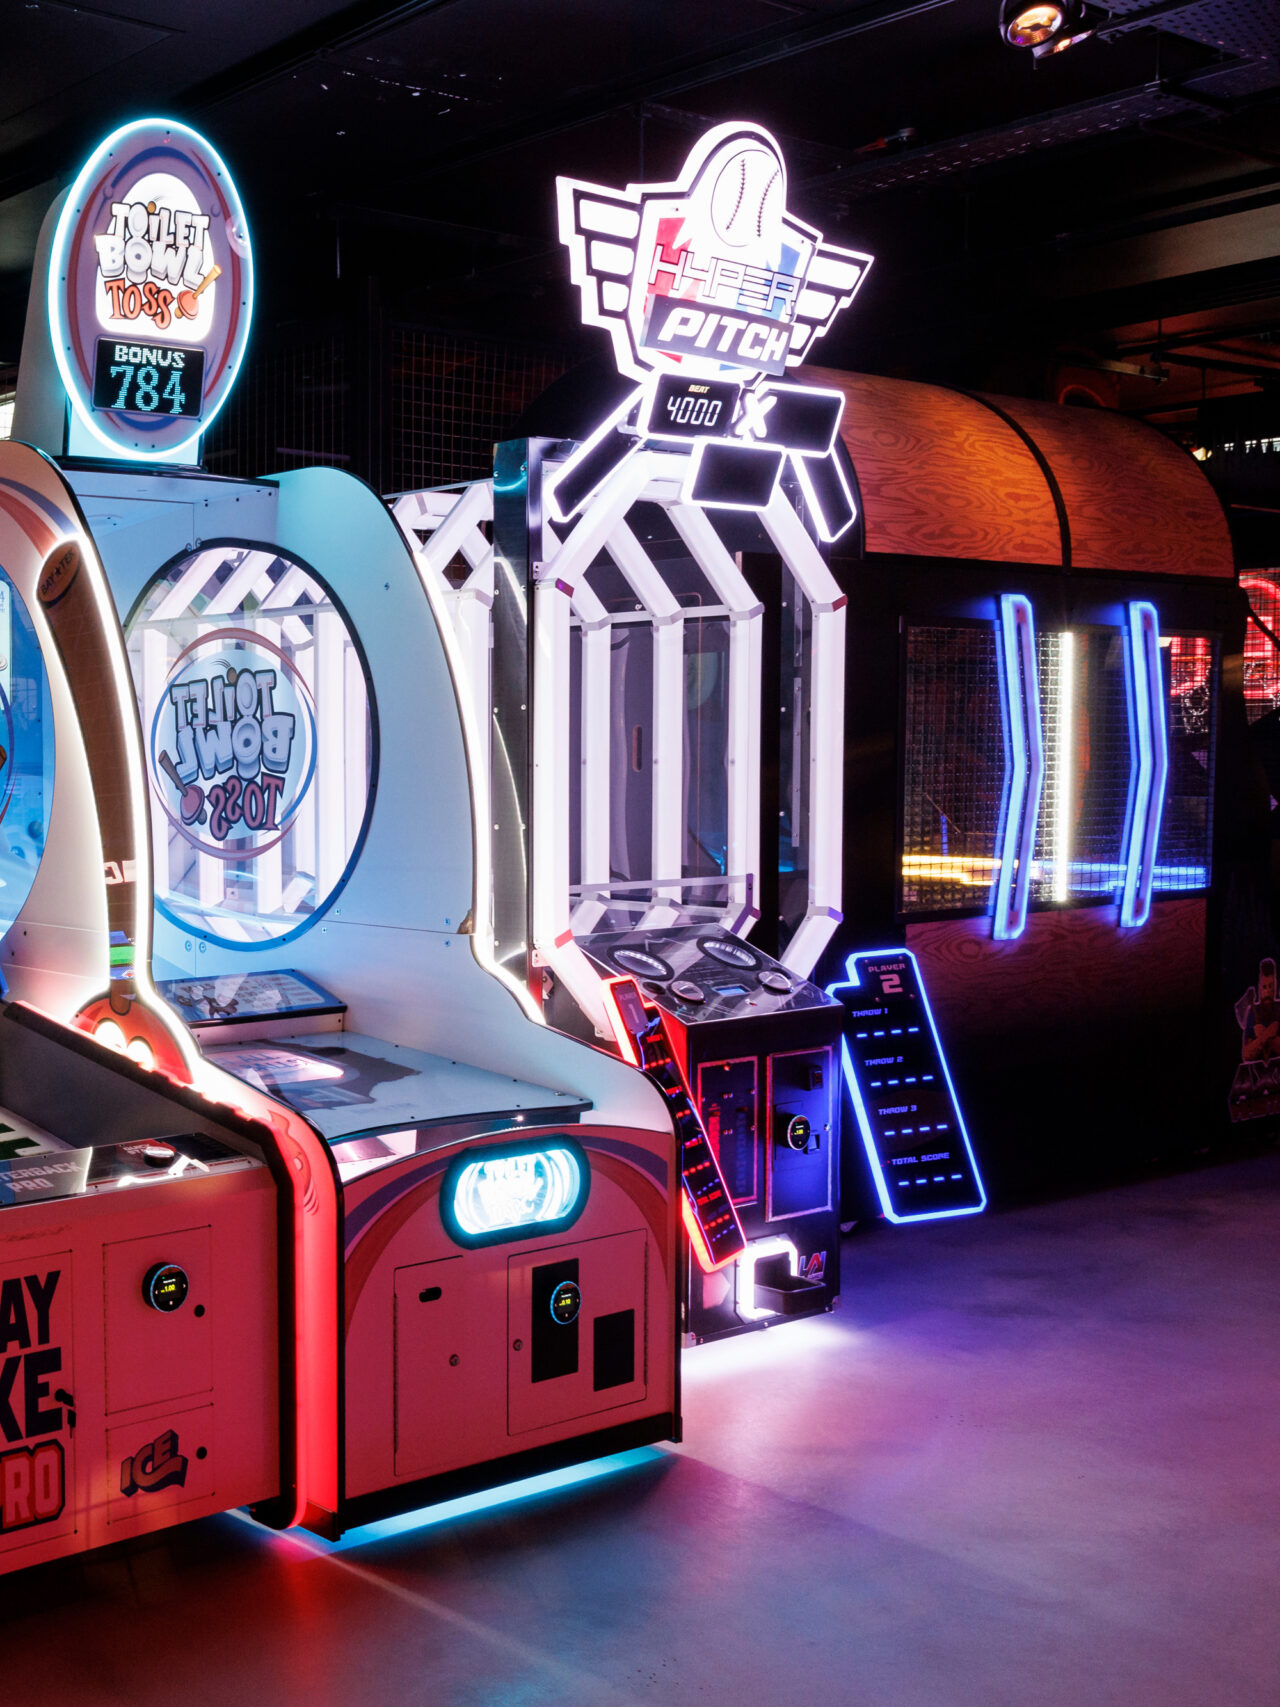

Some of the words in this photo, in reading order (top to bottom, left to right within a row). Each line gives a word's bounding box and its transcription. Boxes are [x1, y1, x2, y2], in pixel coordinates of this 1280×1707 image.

[110, 201, 210, 248] TOILET
[95, 234, 208, 290] BOWL
[648, 243, 801, 318] HYPER
[105, 278, 176, 330] TOSS
[657, 307, 789, 362] PITCH
[114, 345, 186, 368] BONUS
[110, 365, 186, 414] 784
[687, 384, 710, 394] BEAT
[667, 396, 721, 427] 4000
[868, 963, 906, 973] PLAYER
[879, 973, 904, 994] 2
[852, 1008, 882, 1018] THROW
[864, 1056, 895, 1066] THROW
[896, 1056, 904, 1064] 2
[878, 1106, 908, 1116] THROW
[891, 1156, 919, 1166] TOTAL
[920, 1152, 950, 1163] SCORE
[7, 1177, 55, 1194] PRO
[120, 1429, 189, 1498] ICE
